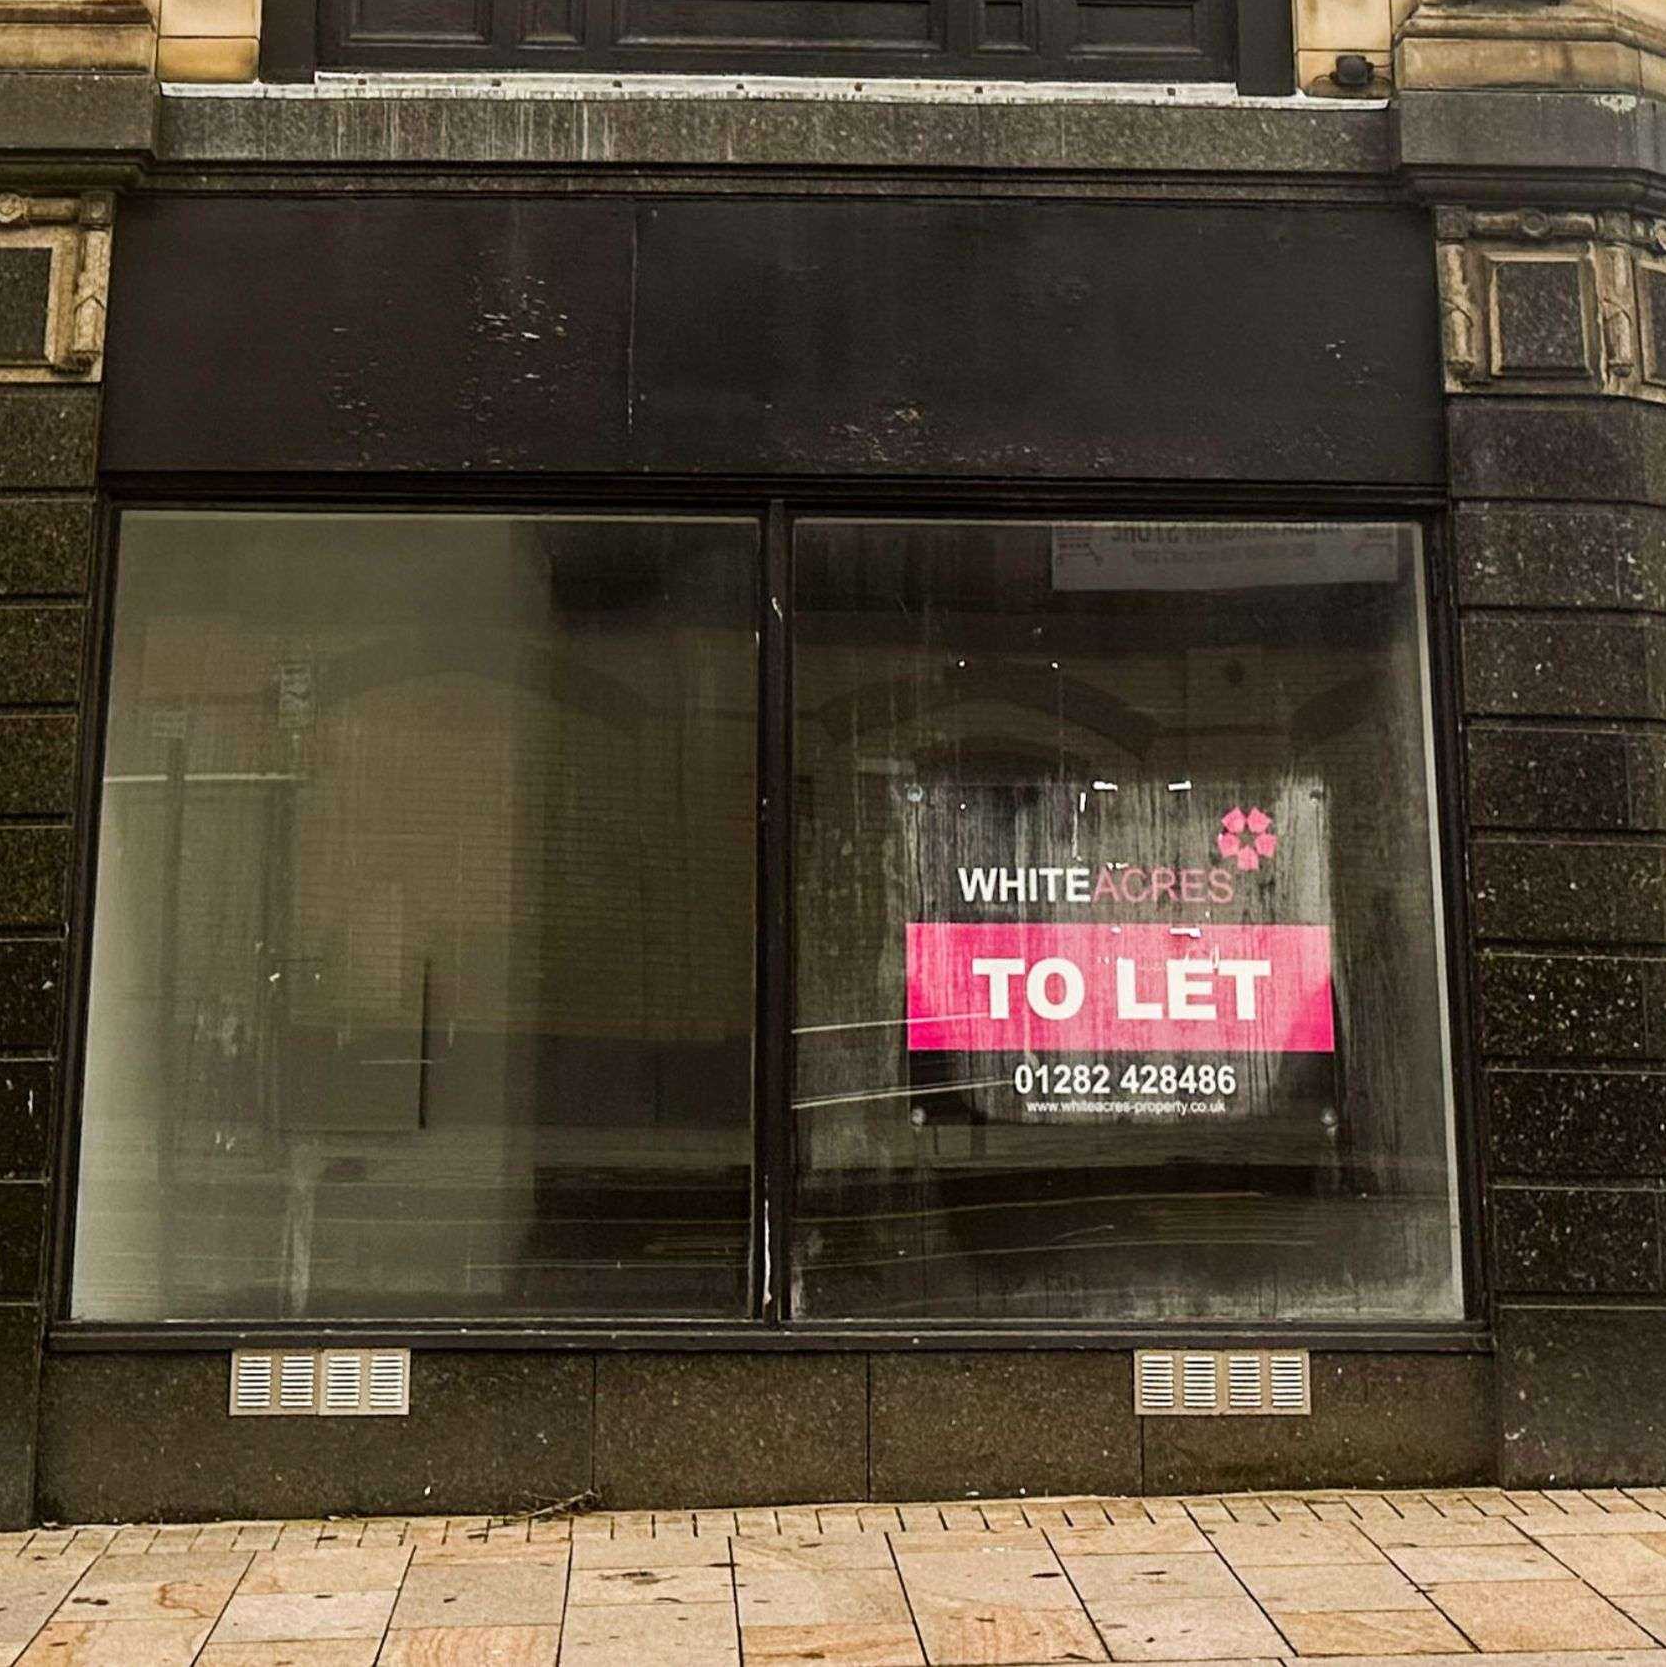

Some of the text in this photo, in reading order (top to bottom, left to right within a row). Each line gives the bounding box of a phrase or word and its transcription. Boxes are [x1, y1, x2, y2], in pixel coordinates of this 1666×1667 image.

[958, 867, 1234, 904] WHITEACRES
[971, 957, 1272, 1022] TO LET
[1014, 1063, 1237, 1096] 01282 428486
